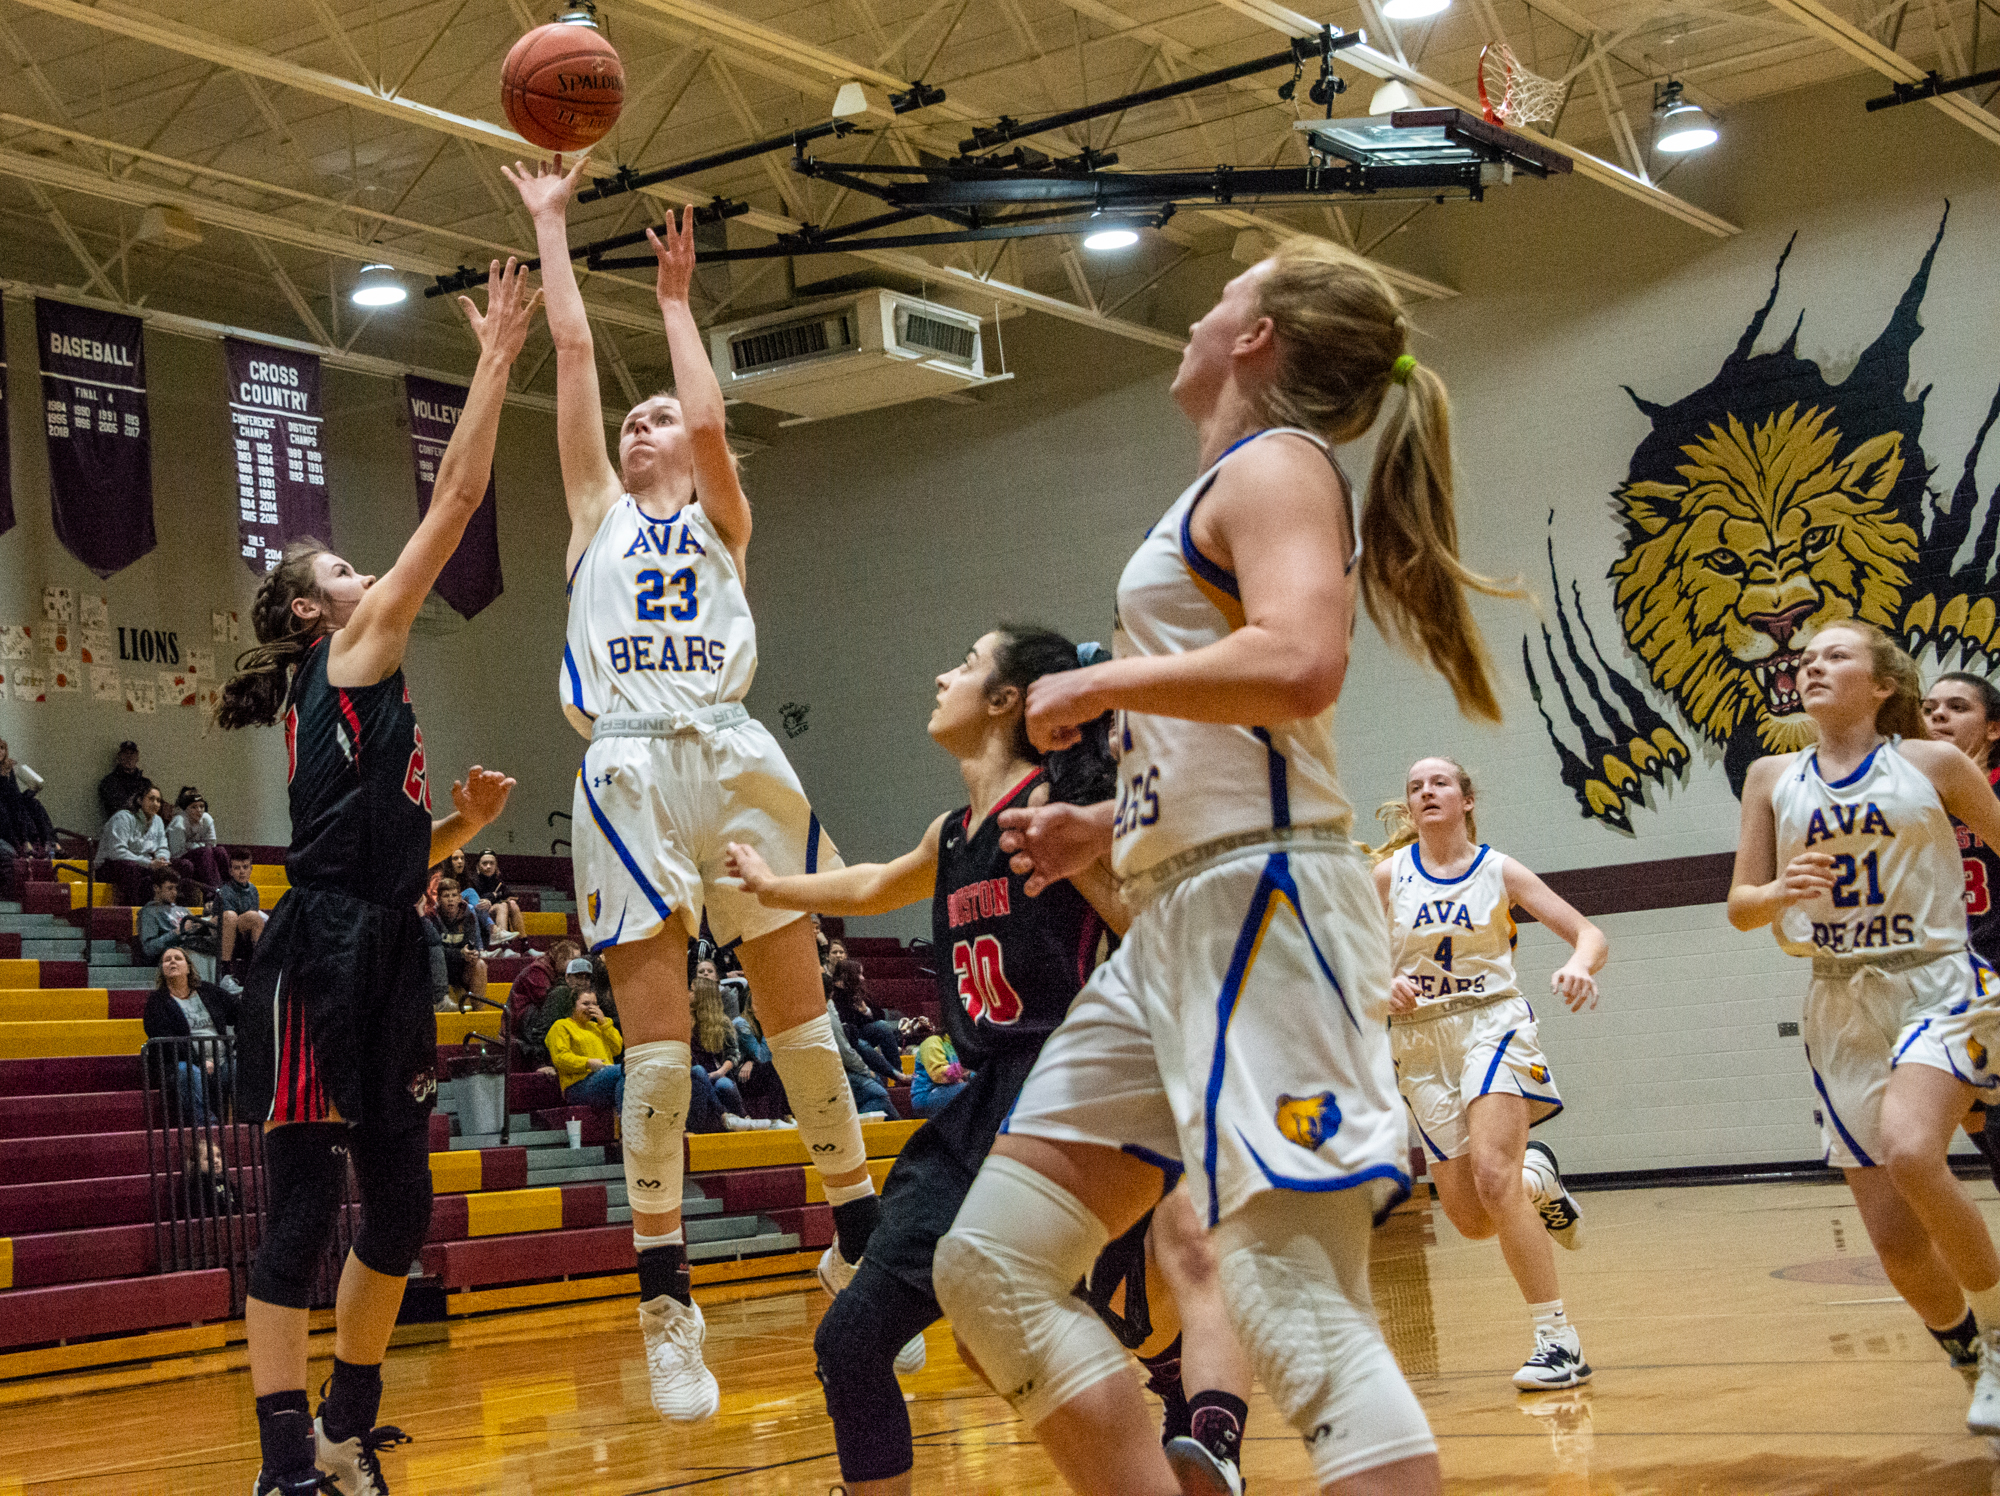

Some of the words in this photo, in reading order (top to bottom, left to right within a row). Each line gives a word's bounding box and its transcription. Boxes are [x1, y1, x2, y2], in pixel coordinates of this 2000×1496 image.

[50, 332, 134, 367] BASEBALL
[249, 360, 299, 387] CROSS
[75, 386, 99, 401] FINAL
[107, 392, 114, 404] 4
[240, 382, 308, 412] COUNTRY
[411, 397, 463, 424] VOLLEY
[232, 412, 276, 429] CONFERENCE
[239, 426, 270, 440] CHAMPS
[287, 421, 318, 436] DISTRICT
[289, 433, 318, 448] CHAMPS
[622, 523, 707, 559] AVA
[635, 565, 699, 622] 23
[117, 626, 180, 665] LIONS
[606, 635, 727, 675] BEARS
[1805, 802, 1896, 848] AVA
[1829, 850, 1886, 909] 21
[1412, 900, 1475, 932] AVA
[1433, 935, 1453, 973] 4
